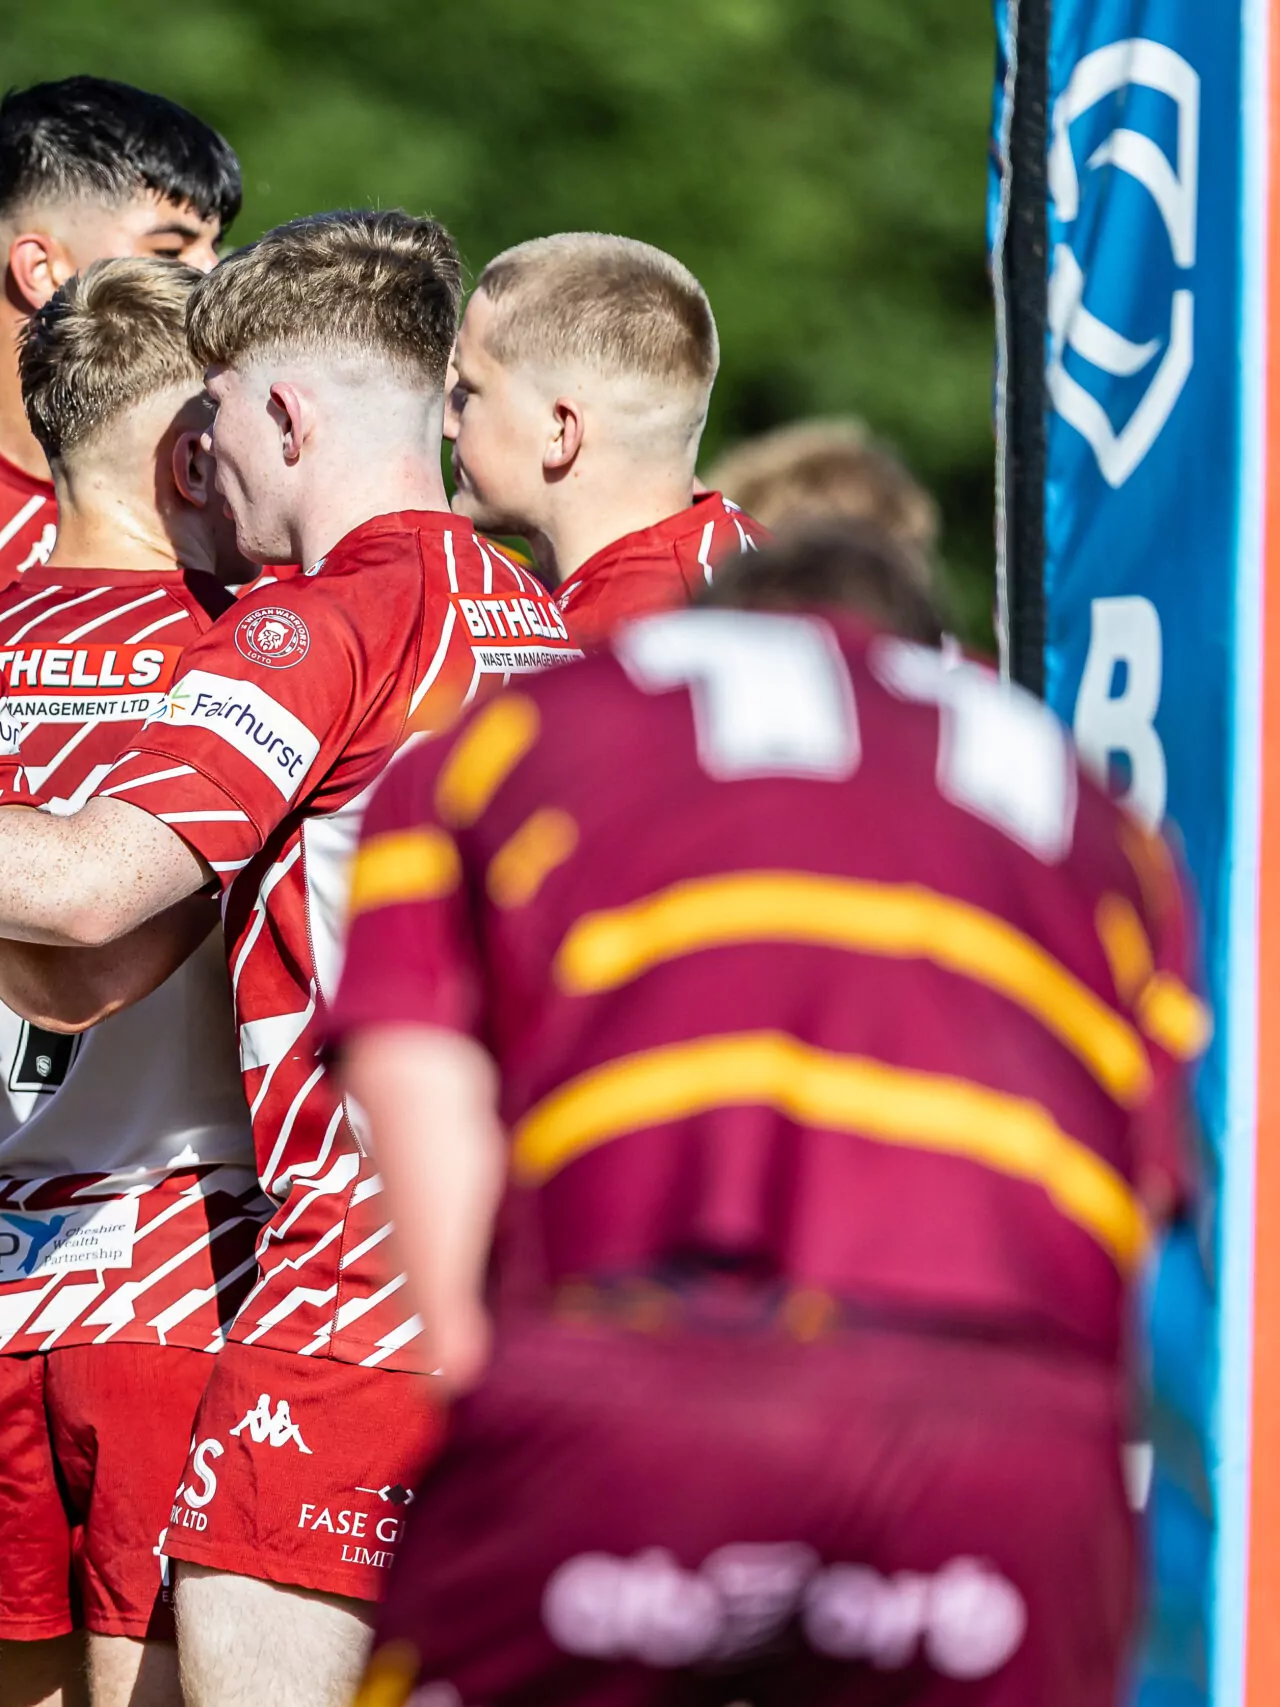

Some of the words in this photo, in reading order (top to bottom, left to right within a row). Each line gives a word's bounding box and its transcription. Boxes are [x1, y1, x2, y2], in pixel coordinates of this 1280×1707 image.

[245, 609, 274, 623] WIGAN
[276, 610, 307, 646] WARRIORS
[458, 598, 569, 641] BITHELLS
[247, 650, 272, 664] LOTTO
[480, 652, 513, 667] WASTE
[121, 699, 150, 713] LTD
[191, 693, 304, 778] Fairhurst
[66, 1223, 127, 1238] Cheshire
[53, 1236, 99, 1250] Wealth
[44, 1249, 123, 1267] Partnership
[182, 1508, 208, 1532] LTD
[297, 1503, 368, 1538] FASE
[341, 1544, 395, 1570] LIMIT
